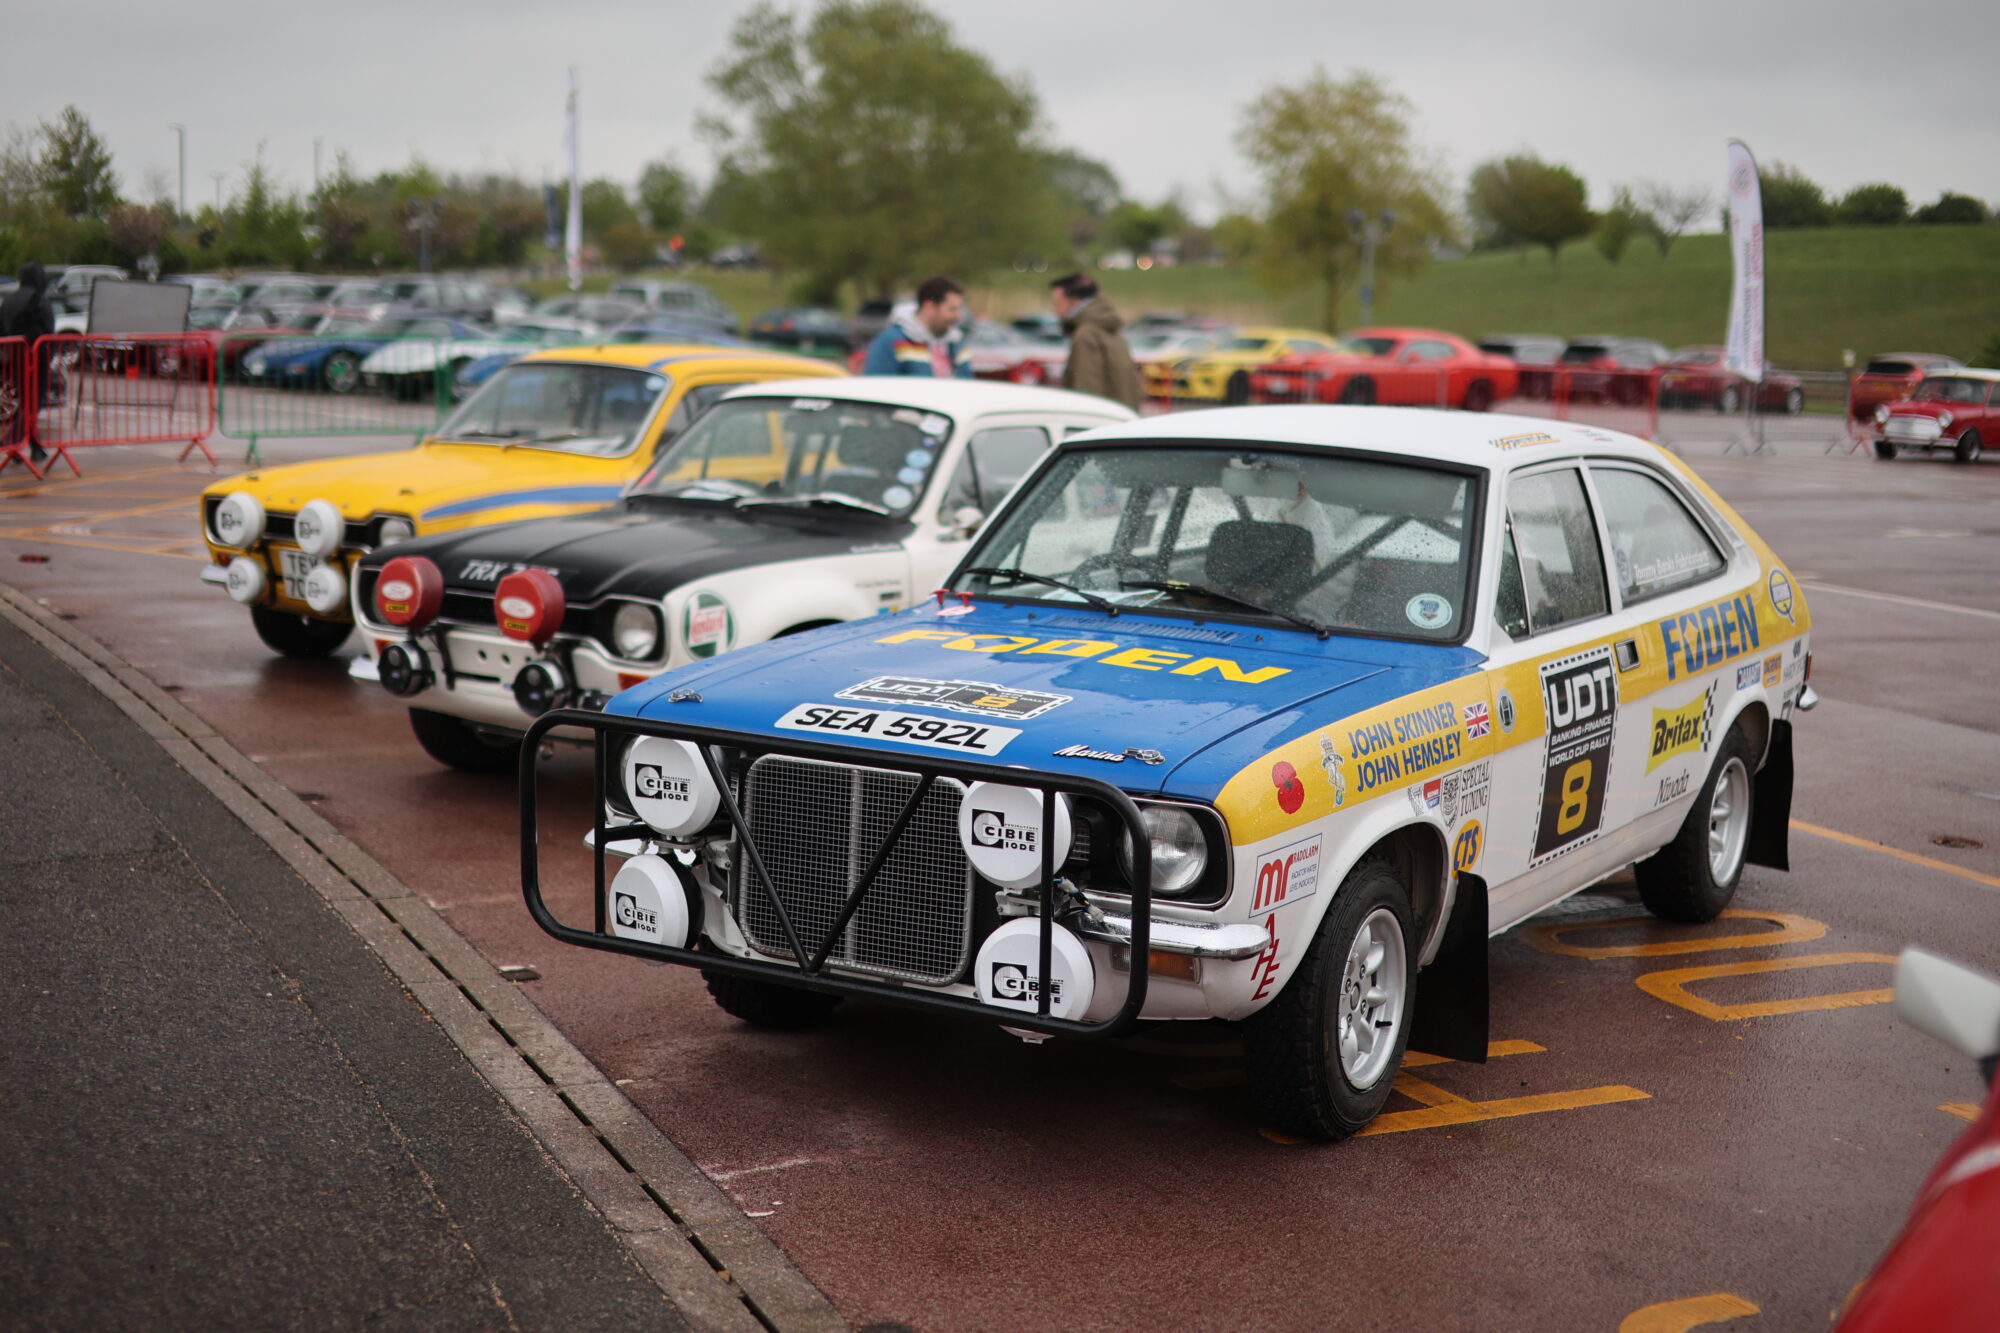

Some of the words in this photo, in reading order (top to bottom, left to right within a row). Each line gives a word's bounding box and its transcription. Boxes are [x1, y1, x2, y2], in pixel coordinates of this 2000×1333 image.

[459, 560, 507, 582] TRX
[1660, 594, 1760, 681] FODEN
[874, 629, 1292, 684] FODEN
[869, 681, 959, 695] UDT
[972, 696, 1017, 708] 8
[1550, 665, 1611, 728] UDT
[795, 706, 880, 734] SEA
[882, 716, 991, 750] 592L
[1348, 720, 1395, 759] JOHN
[1394, 701, 1459, 744] SKINNER
[1652, 713, 1702, 757] Britax
[1052, 744, 1126, 763] Marina
[1356, 752, 1401, 792] JOHN
[1402, 731, 1462, 776] HEMSLEY
[1549, 749, 1574, 768] WORLD
[1574, 742, 1589, 757] CUP
[1590, 734, 1611, 752] RALLY
[1461, 760, 1490, 792] SPECIAL
[663, 792, 689, 802] IODE
[1460, 785, 1488, 817] TUNING
[1557, 759, 1593, 836] 8
[1005, 841, 1036, 852] IODE
[1453, 826, 1479, 871] CTS
[637, 922, 657, 934] IODE
[1006, 978, 1060, 995] CIBE
